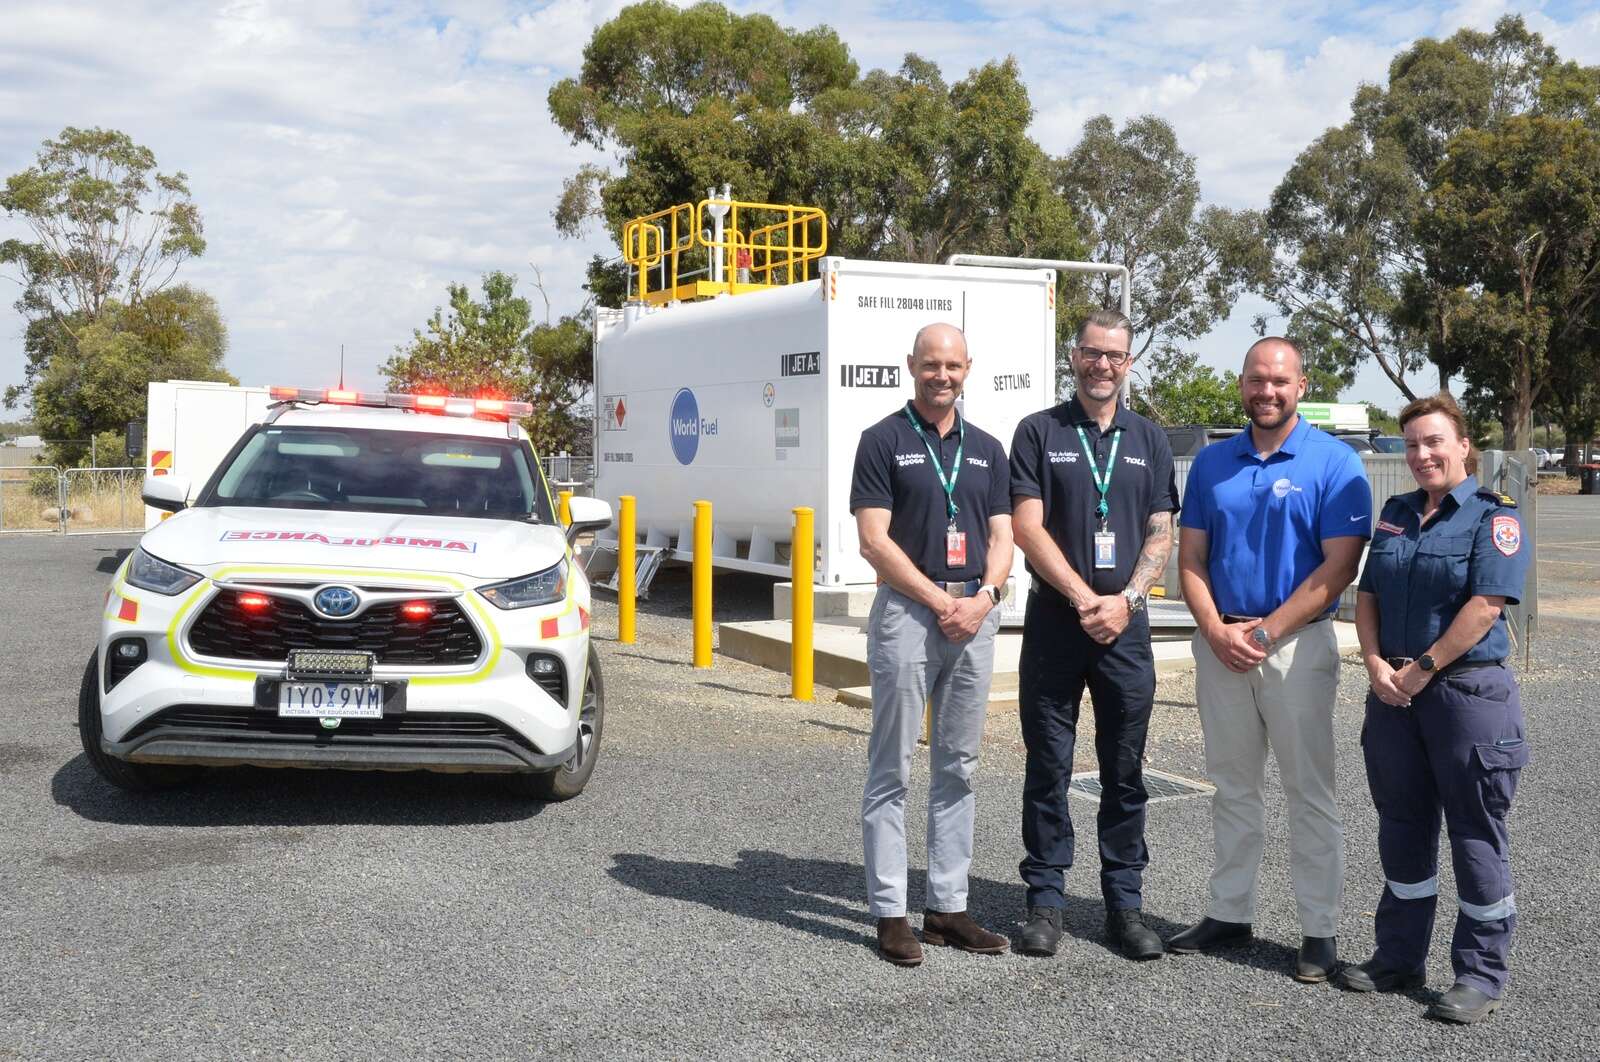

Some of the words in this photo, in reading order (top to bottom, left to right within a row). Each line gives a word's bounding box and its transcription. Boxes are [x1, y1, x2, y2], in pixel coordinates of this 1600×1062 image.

[858, 295, 877, 308] SAFE
[880, 296, 895, 309] FILL
[897, 297, 924, 310] 28048
[926, 299, 953, 311] LITRES
[792, 354, 806, 373] JET
[807, 353, 820, 372] A-1
[856, 367, 879, 386] JET
[881, 368, 900, 386] A-1
[994, 373, 1031, 391] SETTLING
[672, 418, 698, 436] World
[700, 418, 719, 436] Fuel
[966, 457, 989, 467] TOLL
[1123, 456, 1146, 466] TOLL
